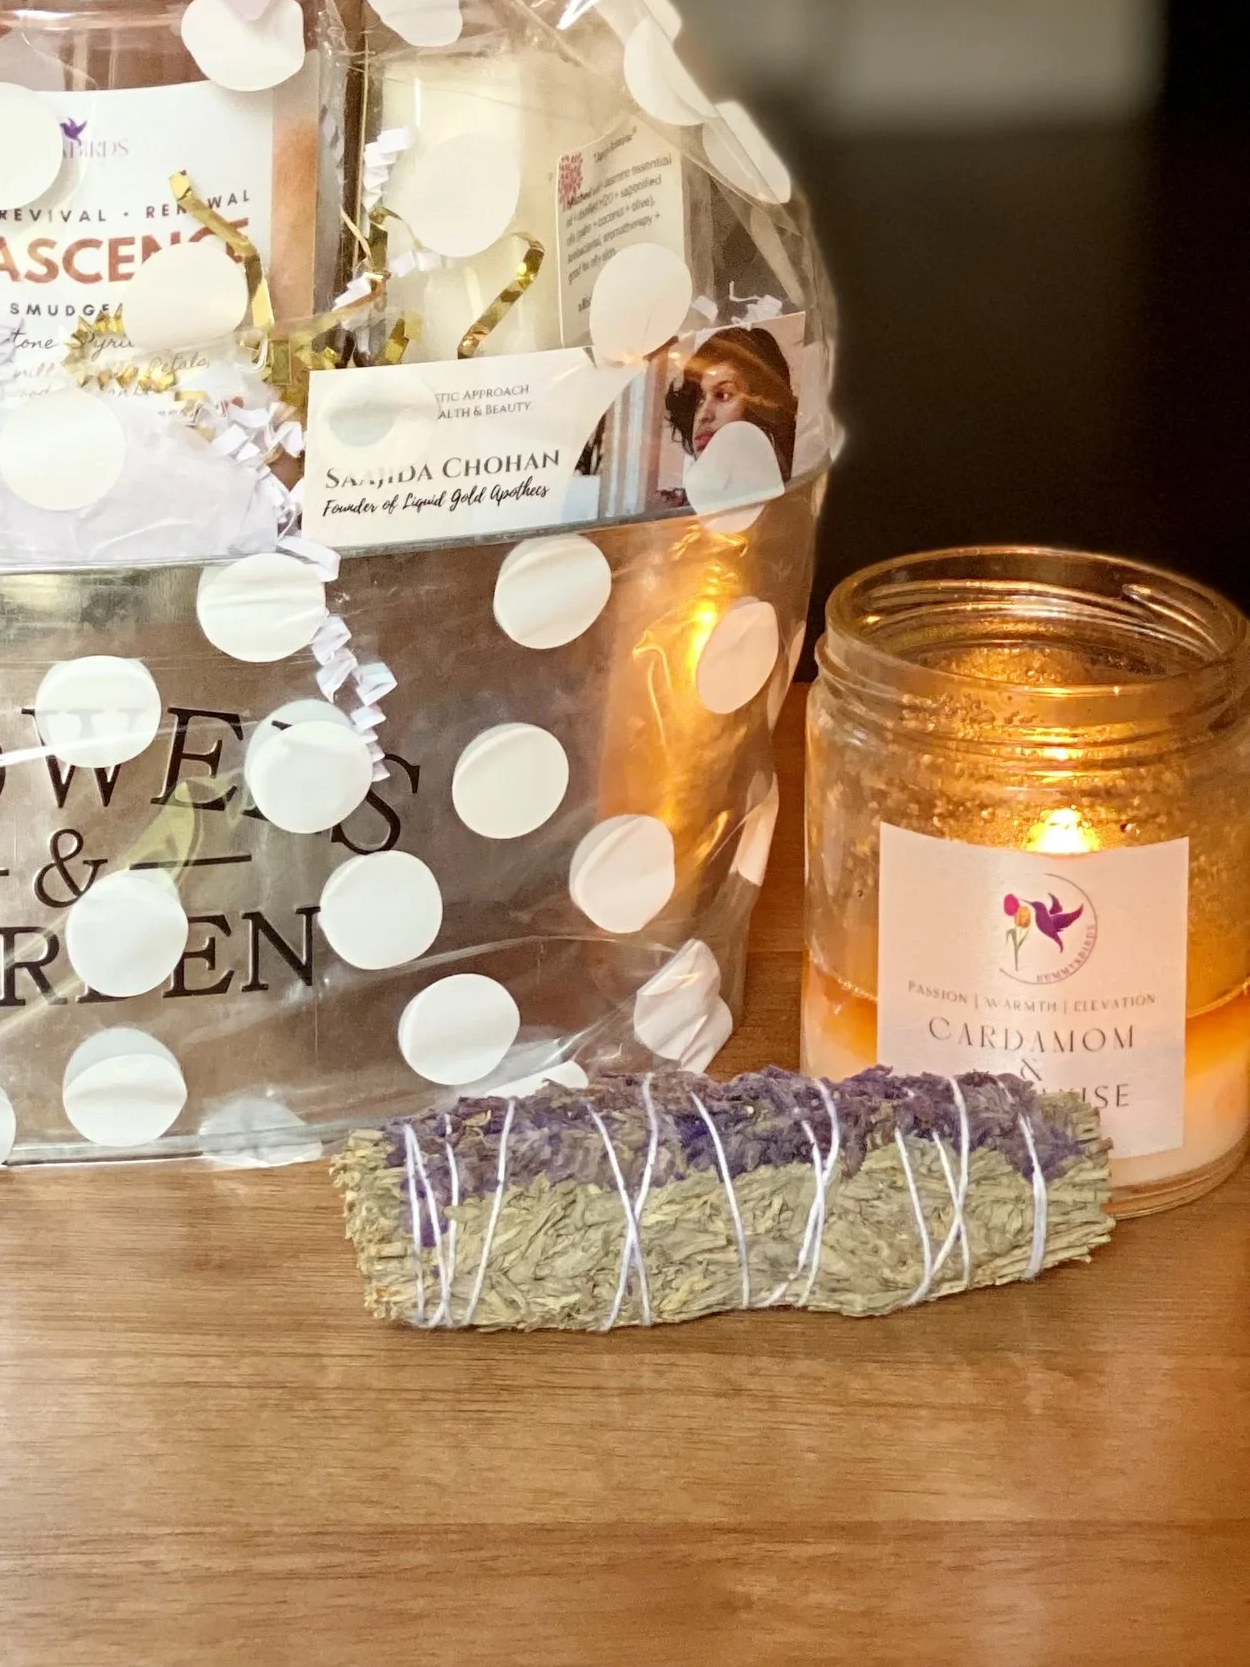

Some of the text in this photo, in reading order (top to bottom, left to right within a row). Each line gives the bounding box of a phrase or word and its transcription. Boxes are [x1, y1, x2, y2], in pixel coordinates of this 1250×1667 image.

[631, 153, 672, 175] essential
[146, 189, 250, 219] RENWAL
[463, 385, 529, 400] APPROACH
[473, 405, 483, 416] &
[486, 401, 531, 415] BEAUTY
[442, 449, 560, 479] CHOHAN
[322, 497, 378, 517] Founder
[382, 493, 399, 515] of
[402, 490, 446, 513] Liquid
[449, 484, 486, 512] Gold
[33, 827, 109, 909] &
[908, 980, 968, 1004] PASSION
[985, 995, 1057, 1013] WARMTH
[1073, 992, 1156, 1013] ELEVATION
[928, 1016, 1134, 1053] CARDAMOM
